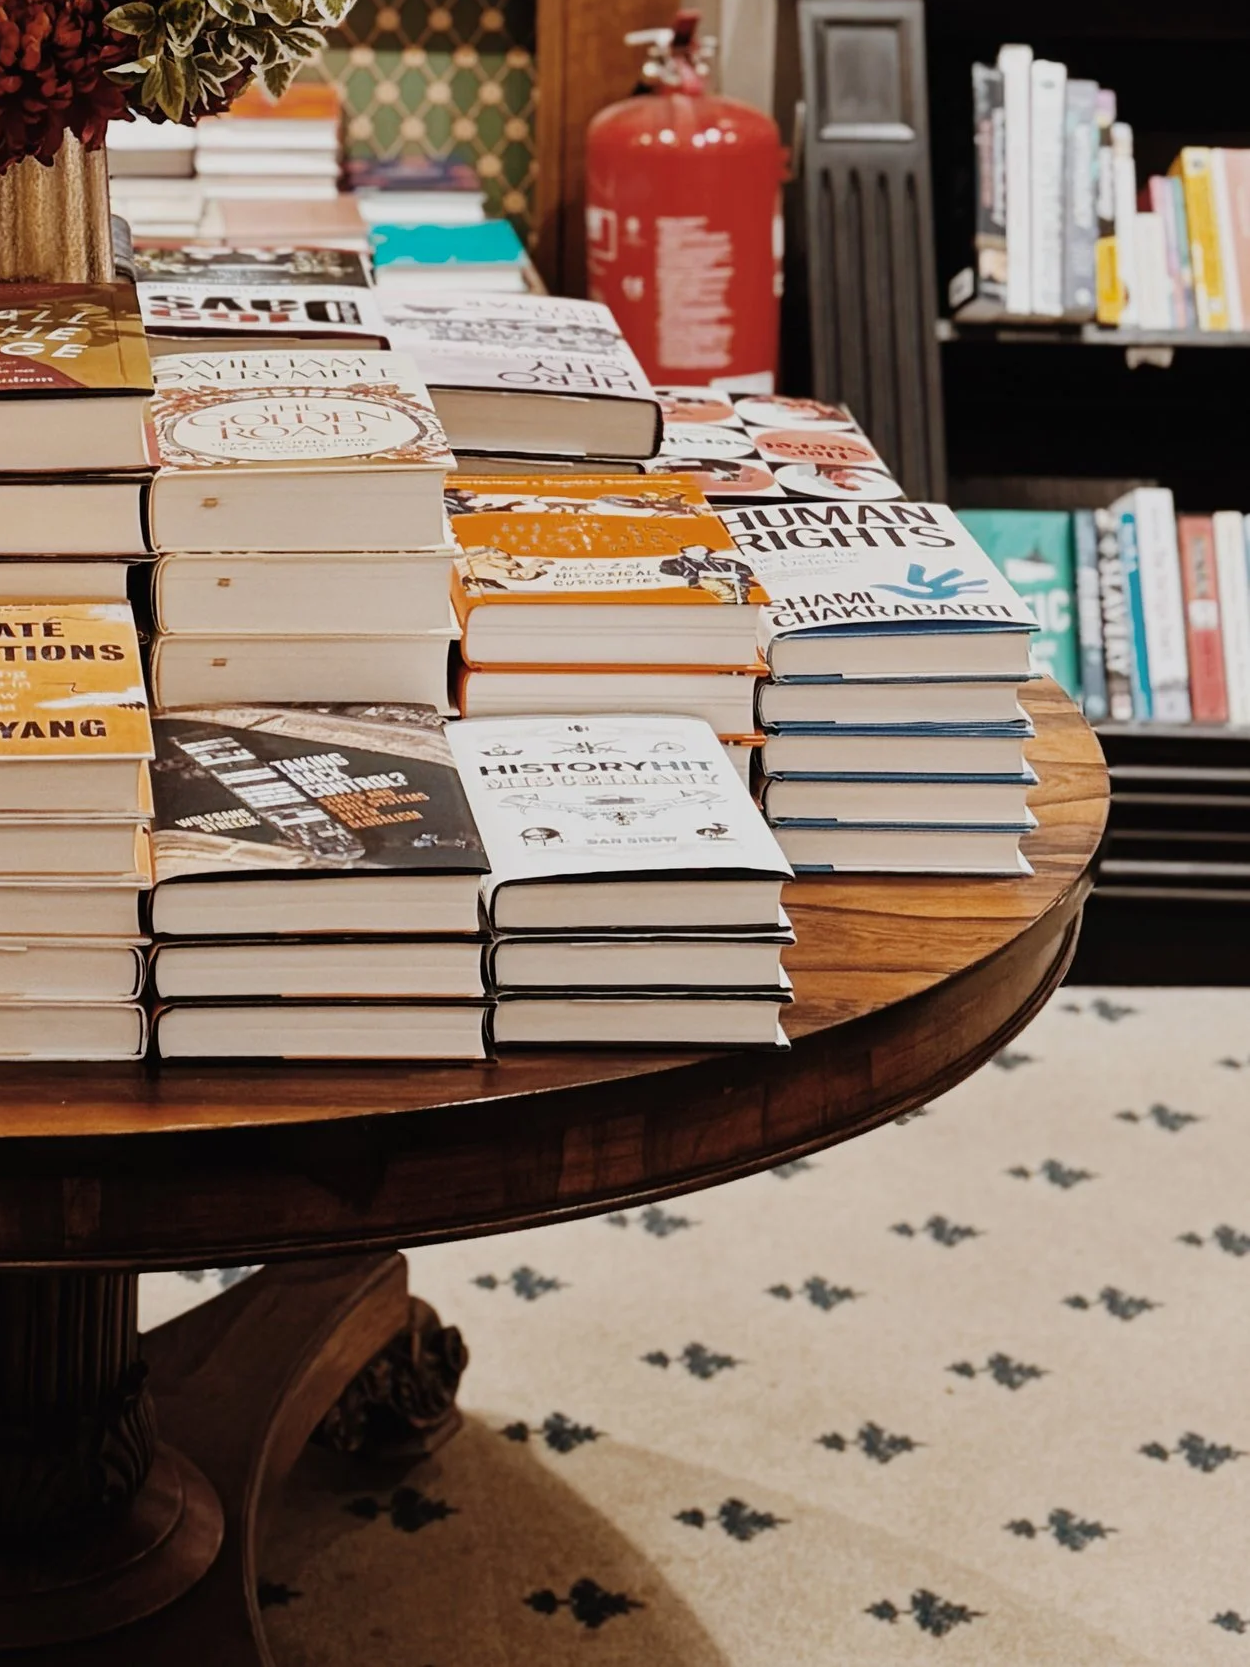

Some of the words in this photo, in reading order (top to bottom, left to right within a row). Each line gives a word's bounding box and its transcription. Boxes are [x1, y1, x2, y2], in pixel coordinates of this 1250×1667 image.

[180, 357, 367, 369] WILLIAM
[529, 361, 630, 378] CITY
[152, 368, 405, 383] DALRYMPLE
[498, 371, 637, 391] HERO
[187, 411, 392, 428] GOLDEN
[219, 424, 368, 440] ROAD
[664, 437, 754, 448] Servi
[718, 504, 939, 534] HUMAN
[728, 526, 956, 556] RIGHTS
[764, 591, 875, 615] SHAMI
[772, 603, 1014, 628] CHAKRABARTI
[14, 679, 31, 690] in
[268, 752, 350, 777] TAKING
[287, 765, 350, 787] BACK
[301, 771, 408, 799] CONTROL?
[485, 773, 720, 791] MISCELLANY
[175, 807, 252, 829] WOLFGANG
